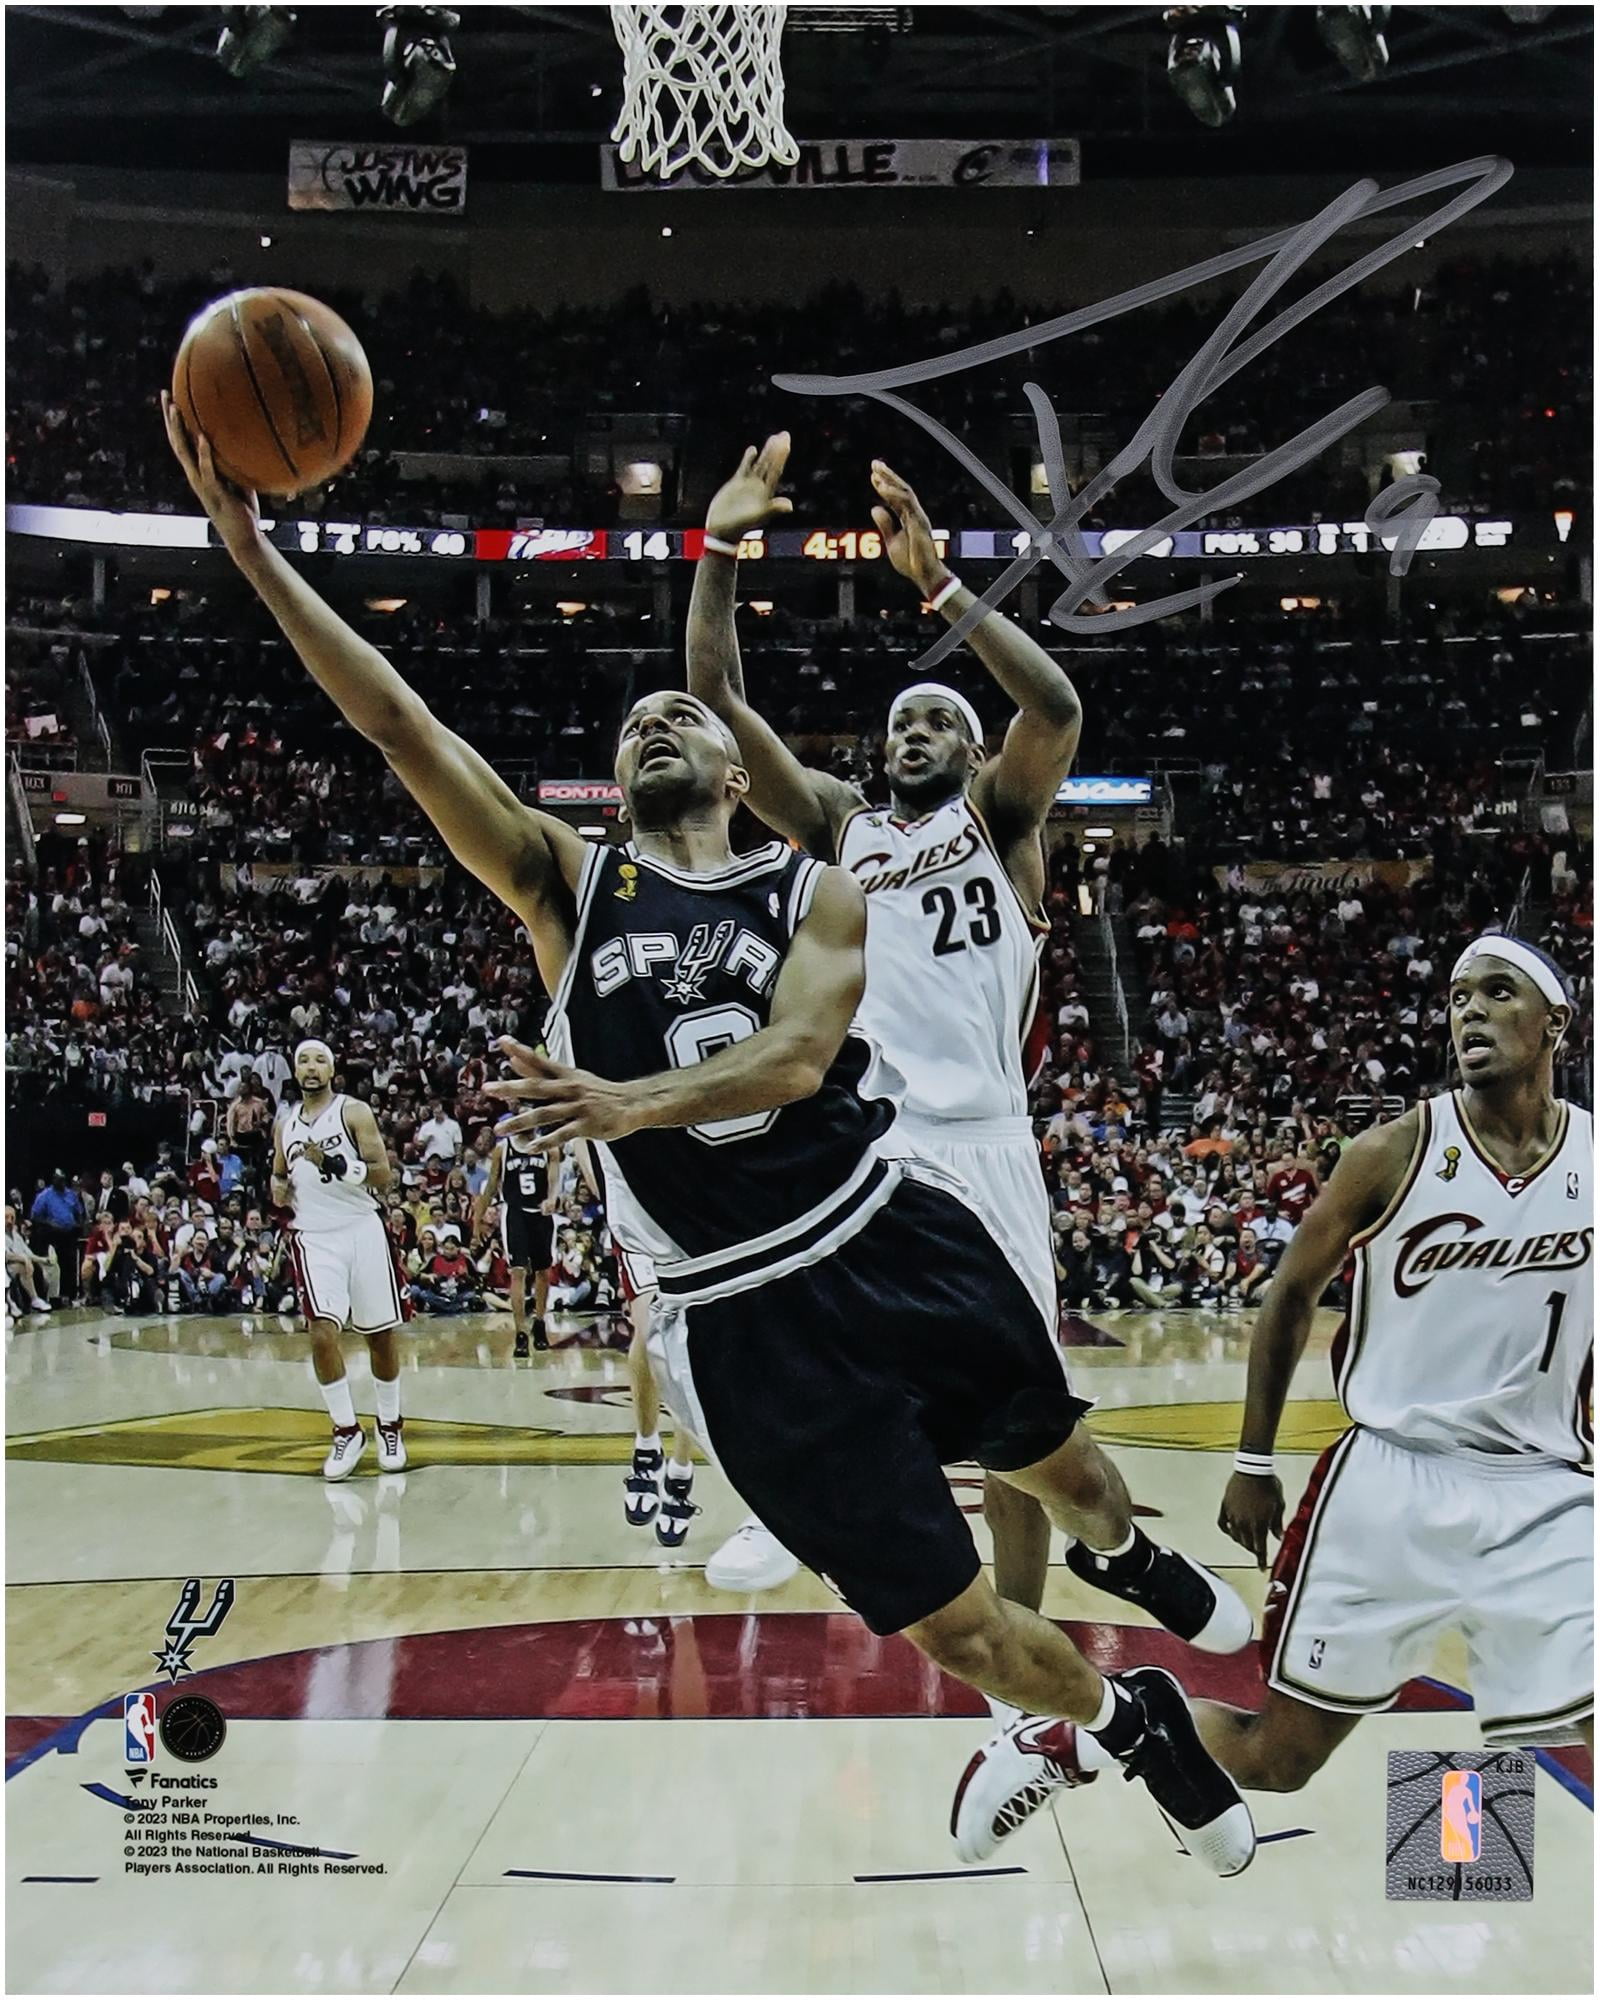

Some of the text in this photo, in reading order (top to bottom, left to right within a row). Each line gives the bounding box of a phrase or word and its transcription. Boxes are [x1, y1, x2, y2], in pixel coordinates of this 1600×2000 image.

[343, 174, 461, 207] WING
[623, 532, 671, 560] 14
[804, 532, 881, 559] 4:16
[540, 785, 623, 799] PONTIA
[921, 876, 1002, 957] 23
[591, 920, 782, 1004] SPUR
[519, 1173, 536, 1195] 5
[1538, 1290, 1568, 1374] 1
[1495, 1760, 1524, 1774] KJB
[1407, 1877, 1512, 1891] NC12956033
